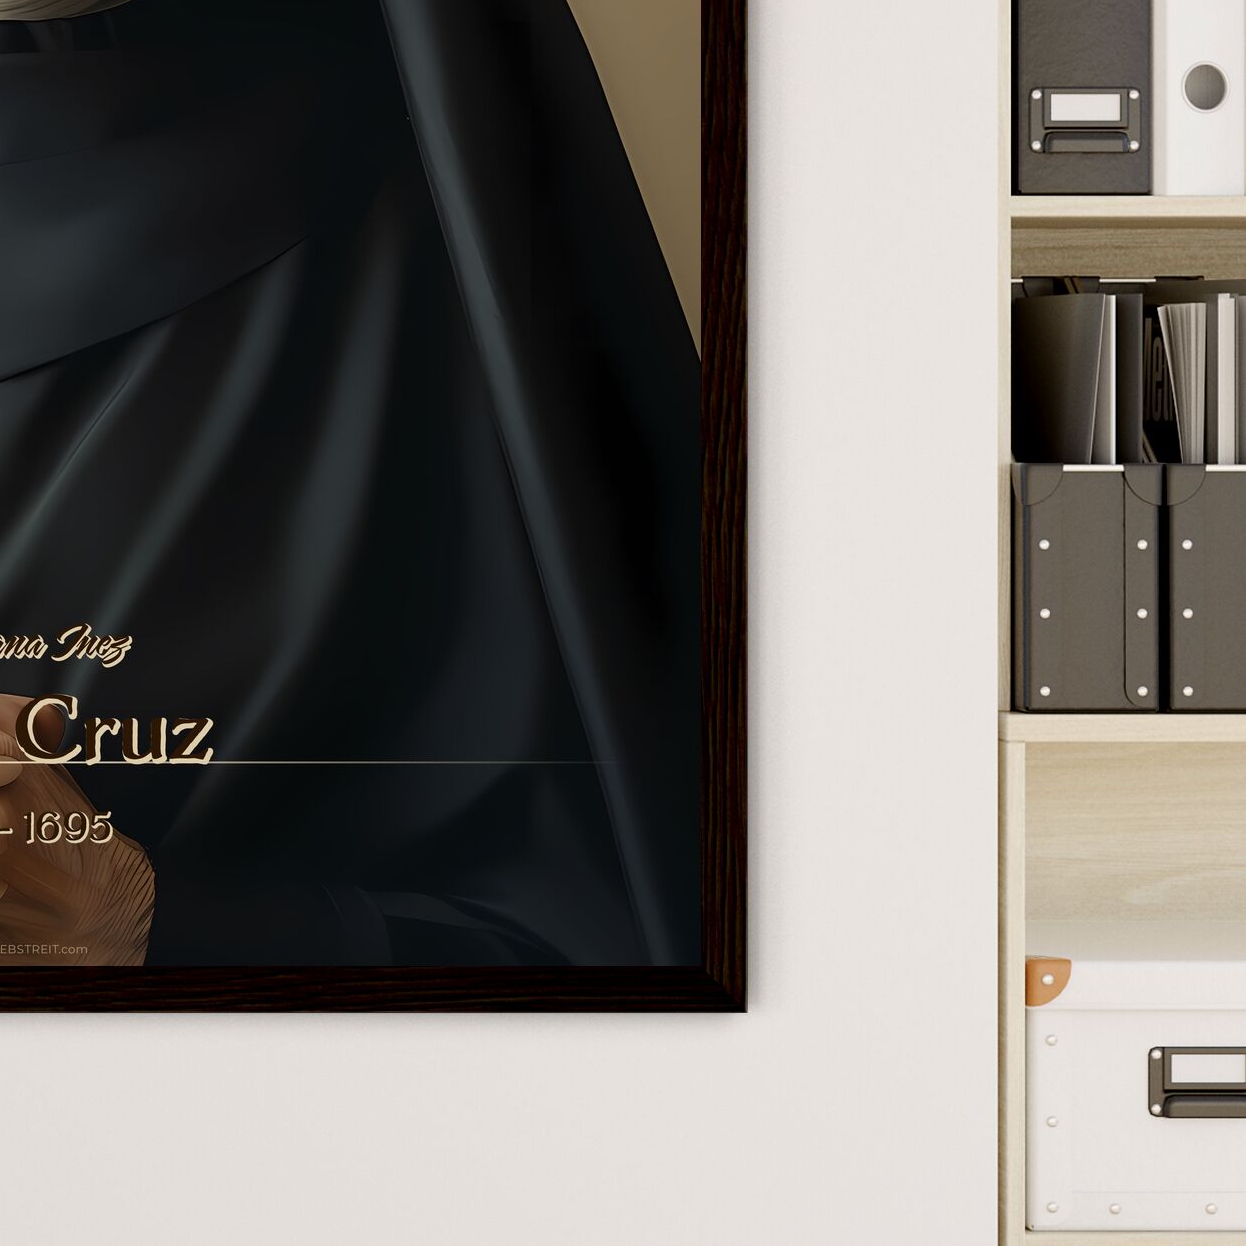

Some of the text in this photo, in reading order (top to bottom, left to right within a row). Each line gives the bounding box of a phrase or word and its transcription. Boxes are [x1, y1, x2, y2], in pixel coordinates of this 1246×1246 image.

[51, 623, 133, 668] Inez
[14, 693, 214, 766] Cruz
[23, 810, 114, 844] 1695
